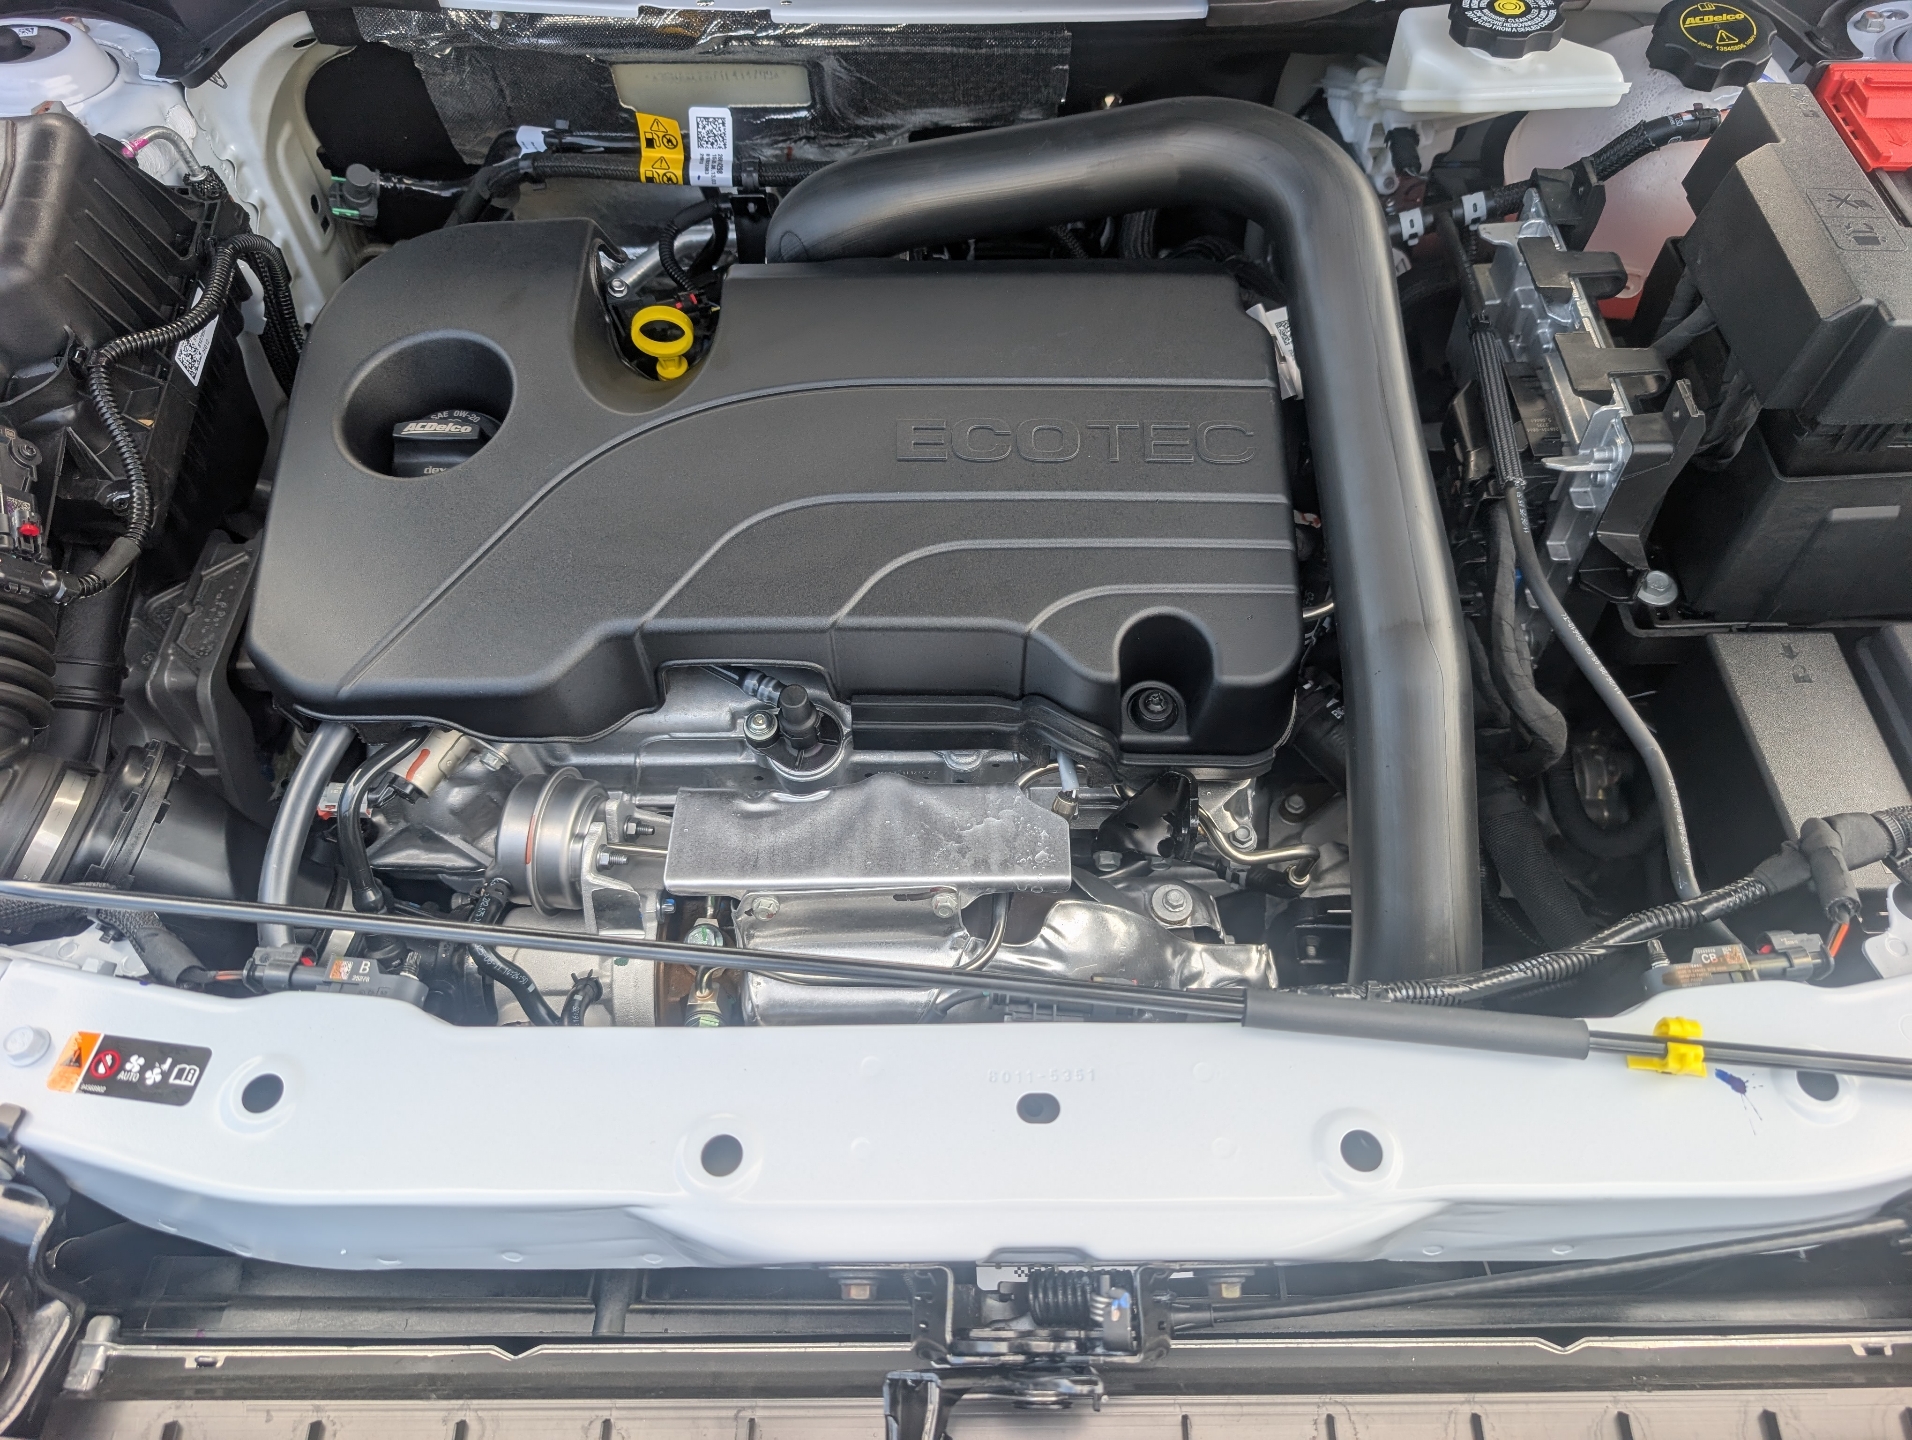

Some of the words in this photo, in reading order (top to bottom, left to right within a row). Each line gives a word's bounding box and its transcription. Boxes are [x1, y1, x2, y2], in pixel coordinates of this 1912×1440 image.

[1685, 13, 1745, 24] ACDelco
[431, 410, 449, 420] SAE
[453, 410, 481, 423] 0W-20
[401, 422, 472, 434] ACDelco
[895, 418, 1255, 464] ECOTEC
[1701, 953, 1719, 964] CB
[359, 960, 371, 974] B
[117, 1070, 140, 1082] AUTO
